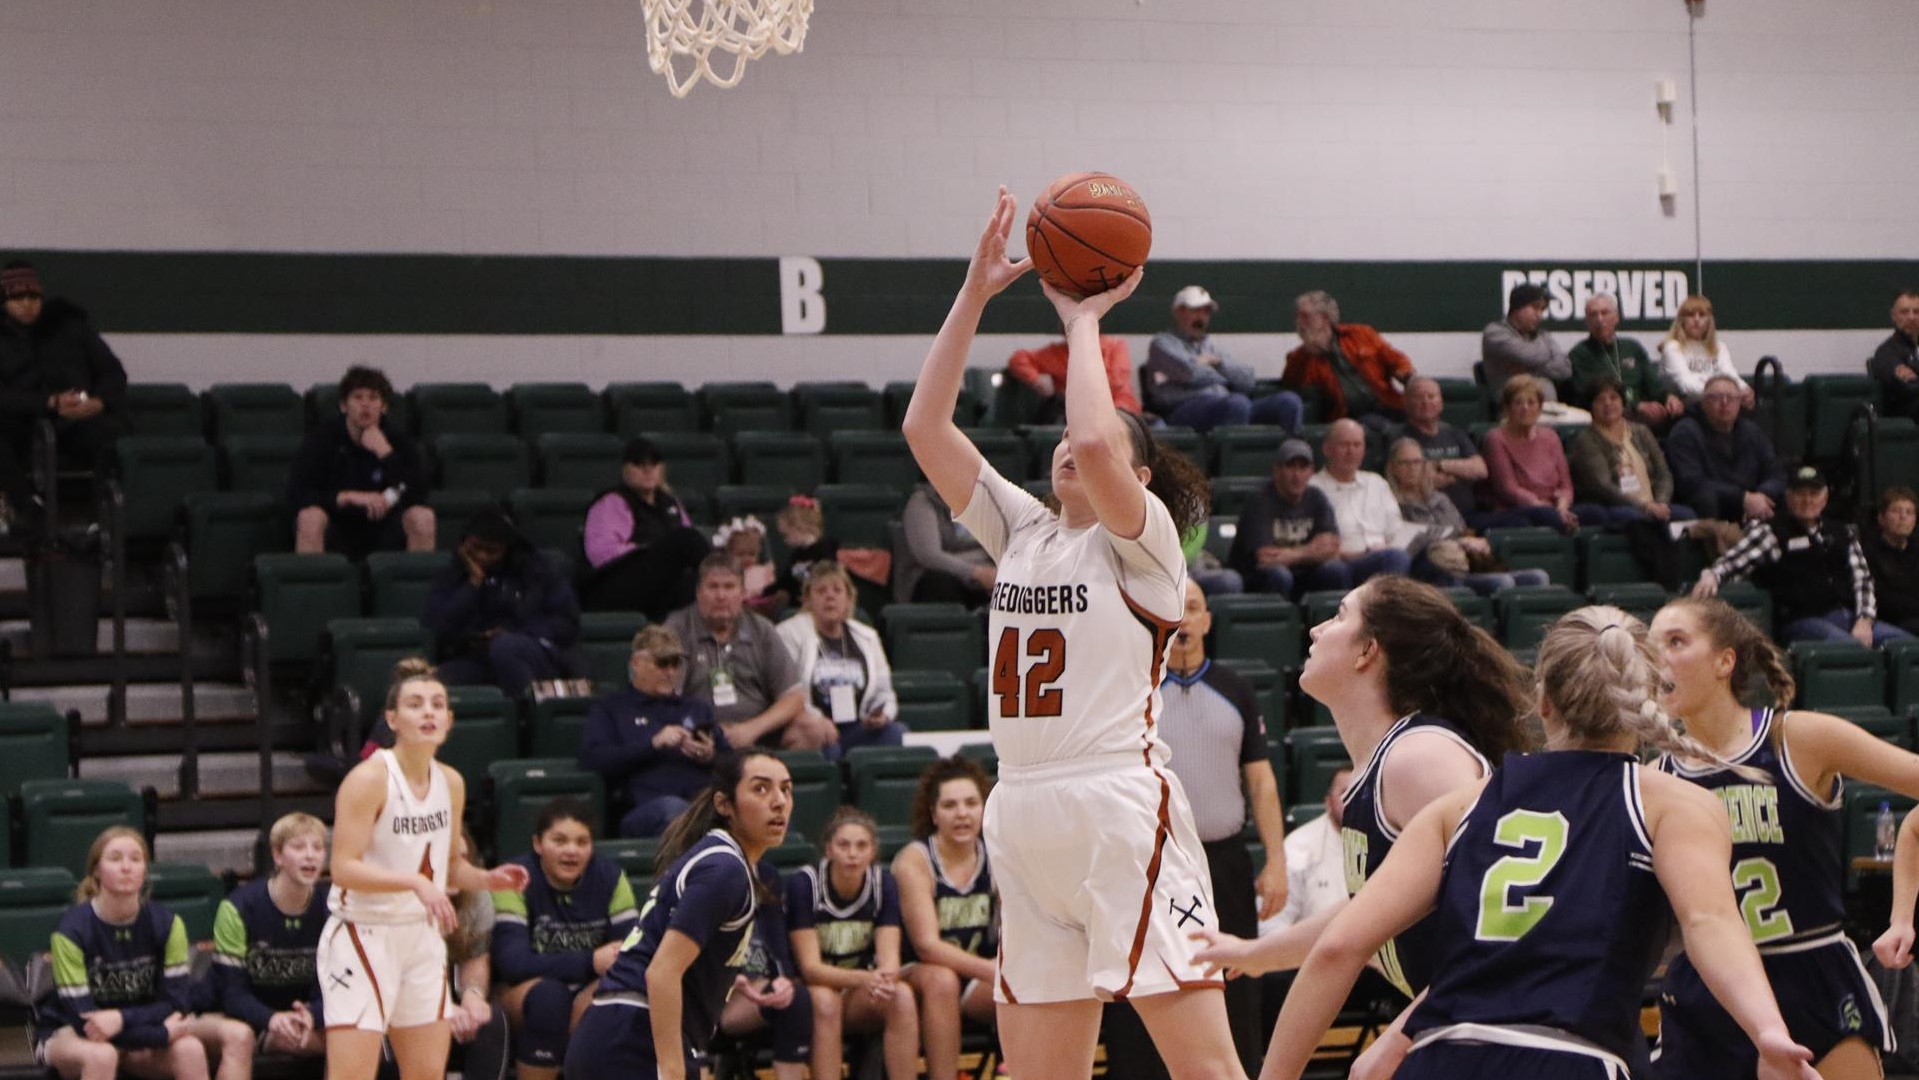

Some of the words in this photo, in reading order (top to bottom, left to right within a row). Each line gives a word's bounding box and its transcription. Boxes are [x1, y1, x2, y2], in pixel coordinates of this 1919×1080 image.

[780, 256, 827, 334] B
[993, 582, 1088, 614] REDIGGERS
[993, 626, 1066, 718] 42
[1474, 807, 1570, 942] 2
[1732, 857, 1794, 944] 2
